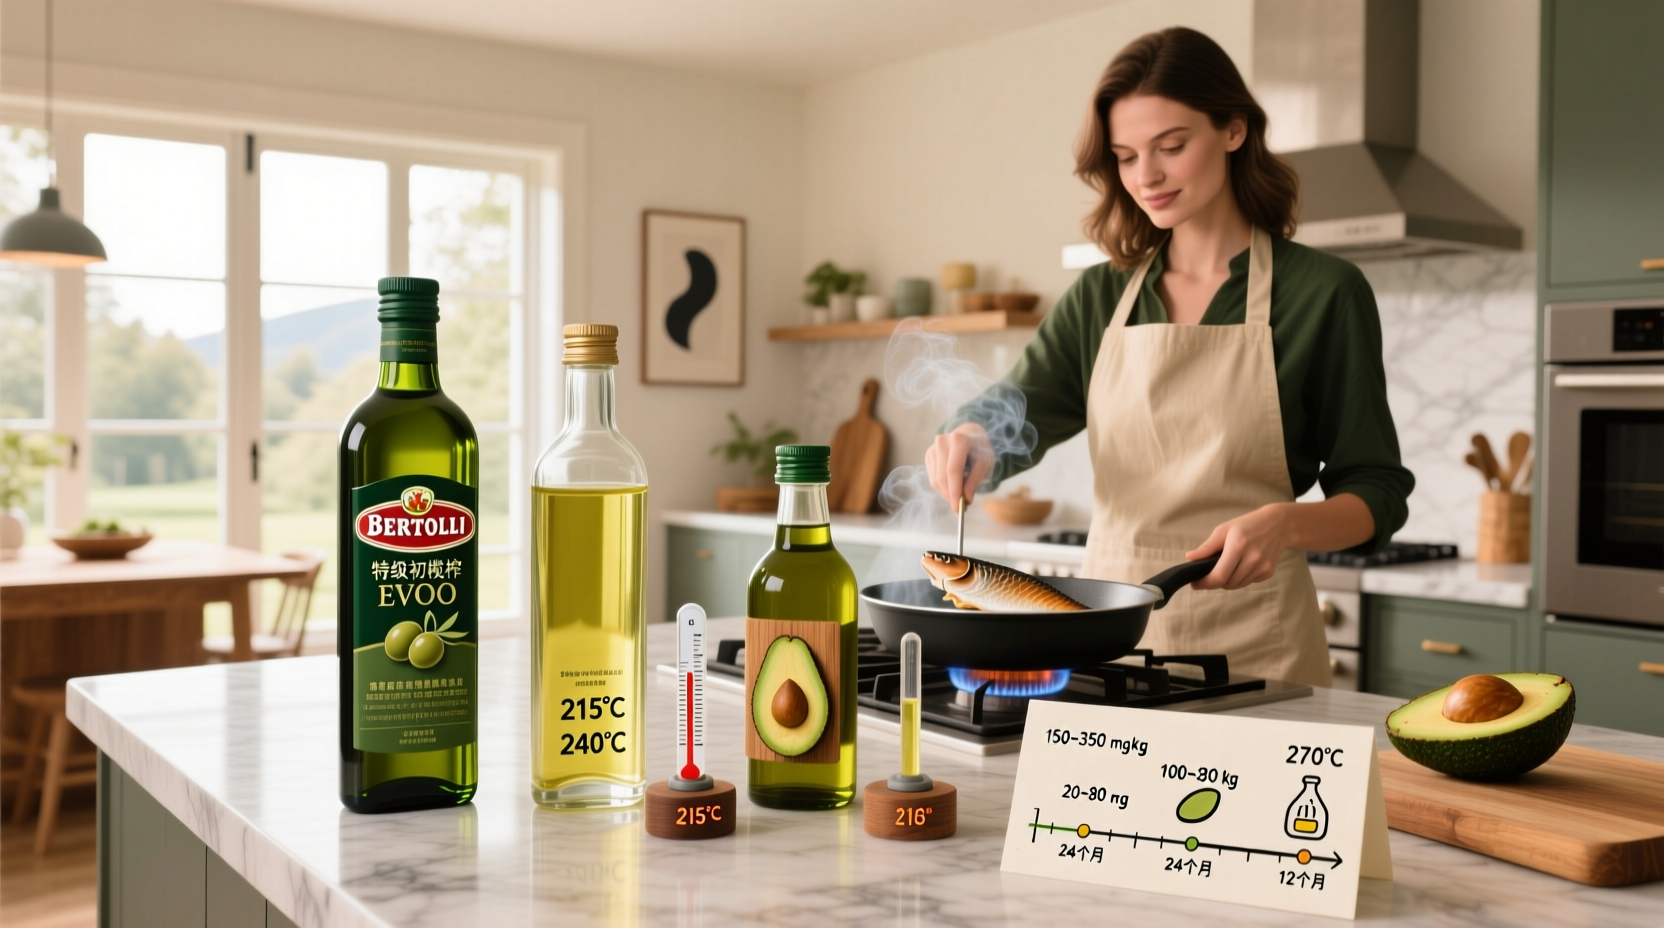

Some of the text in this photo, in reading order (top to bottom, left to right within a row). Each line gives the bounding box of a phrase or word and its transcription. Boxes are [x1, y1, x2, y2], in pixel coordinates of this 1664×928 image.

[367, 514, 466, 537] BERTOLLI
[378, 582, 457, 607] EVOO
[560, 696, 626, 721] 215°C
[560, 731, 626, 756] 240°C
[1111, 737, 1148, 756] mgkg
[1286, 745, 1343, 767] 270°C
[1222, 770, 1238, 790] kg
[676, 805, 722, 826] 215°C
[1059, 844, 1103, 863] 24个月
[1165, 857, 1211, 877] 24个月
[1280, 871, 1324, 890] 12个月
